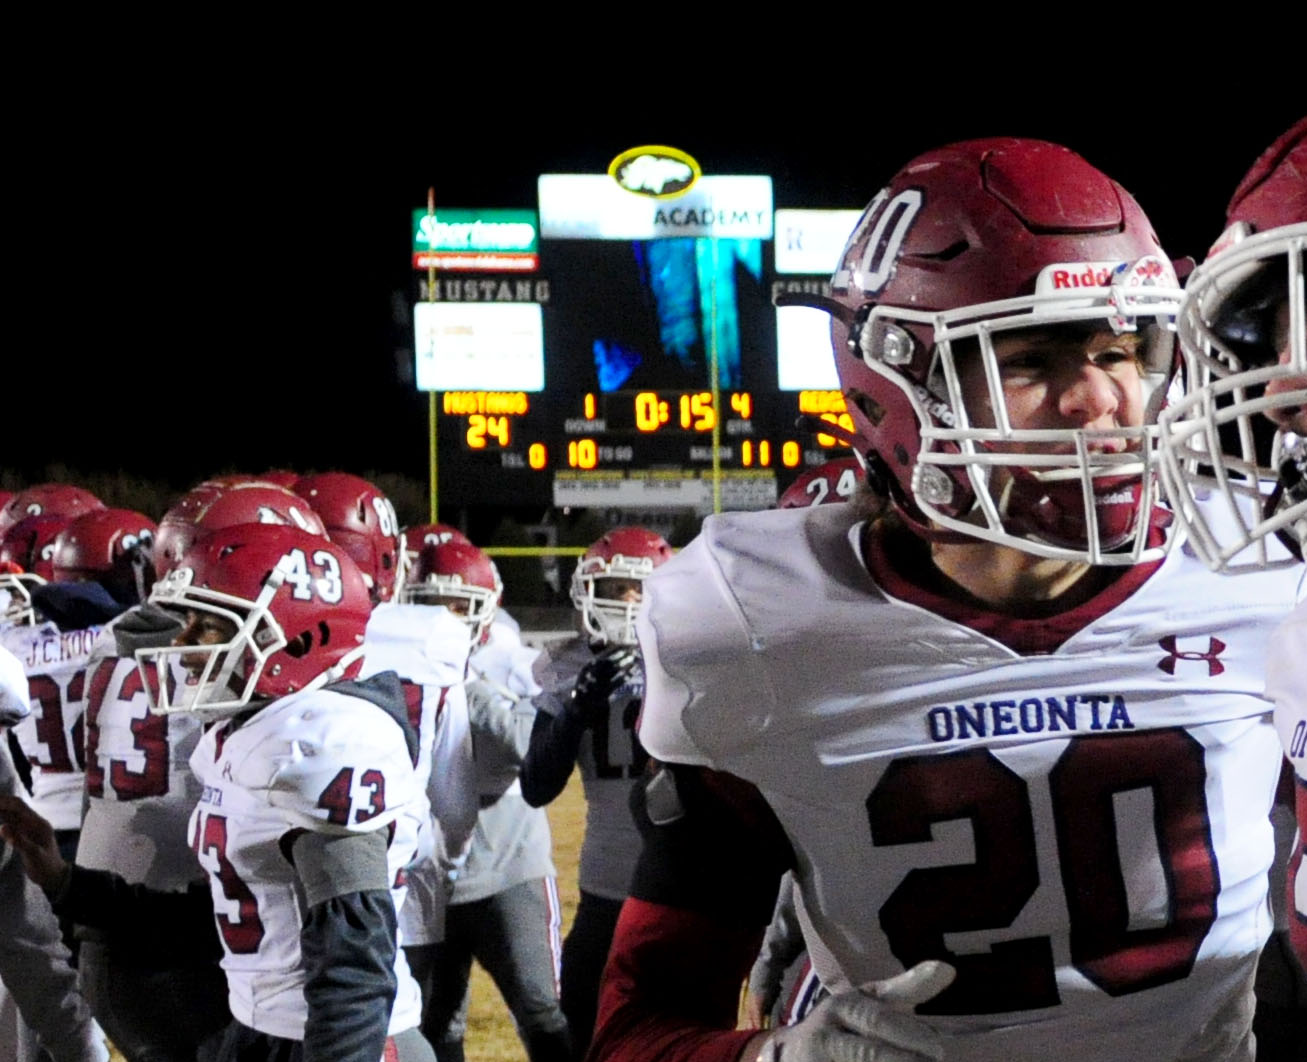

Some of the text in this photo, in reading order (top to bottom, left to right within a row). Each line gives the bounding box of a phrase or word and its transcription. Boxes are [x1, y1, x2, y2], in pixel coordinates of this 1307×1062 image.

[654, 208, 765, 227] ACADEMY
[419, 280, 550, 301] MUSTANG
[1053, 264, 1113, 289] Ridd
[635, 392, 717, 431] 0:15
[731, 392, 750, 419] 4
[466, 414, 509, 448] 24
[529, 443, 547, 470] 0
[568, 438, 597, 469] 10
[806, 469, 857, 507] 24
[285, 548, 343, 604] 43
[26, 629, 101, 669] J.C.MOO
[927, 694, 1136, 743] ONEONTA
[318, 766, 385, 826] 43
[866, 725, 1222, 1017] 20
